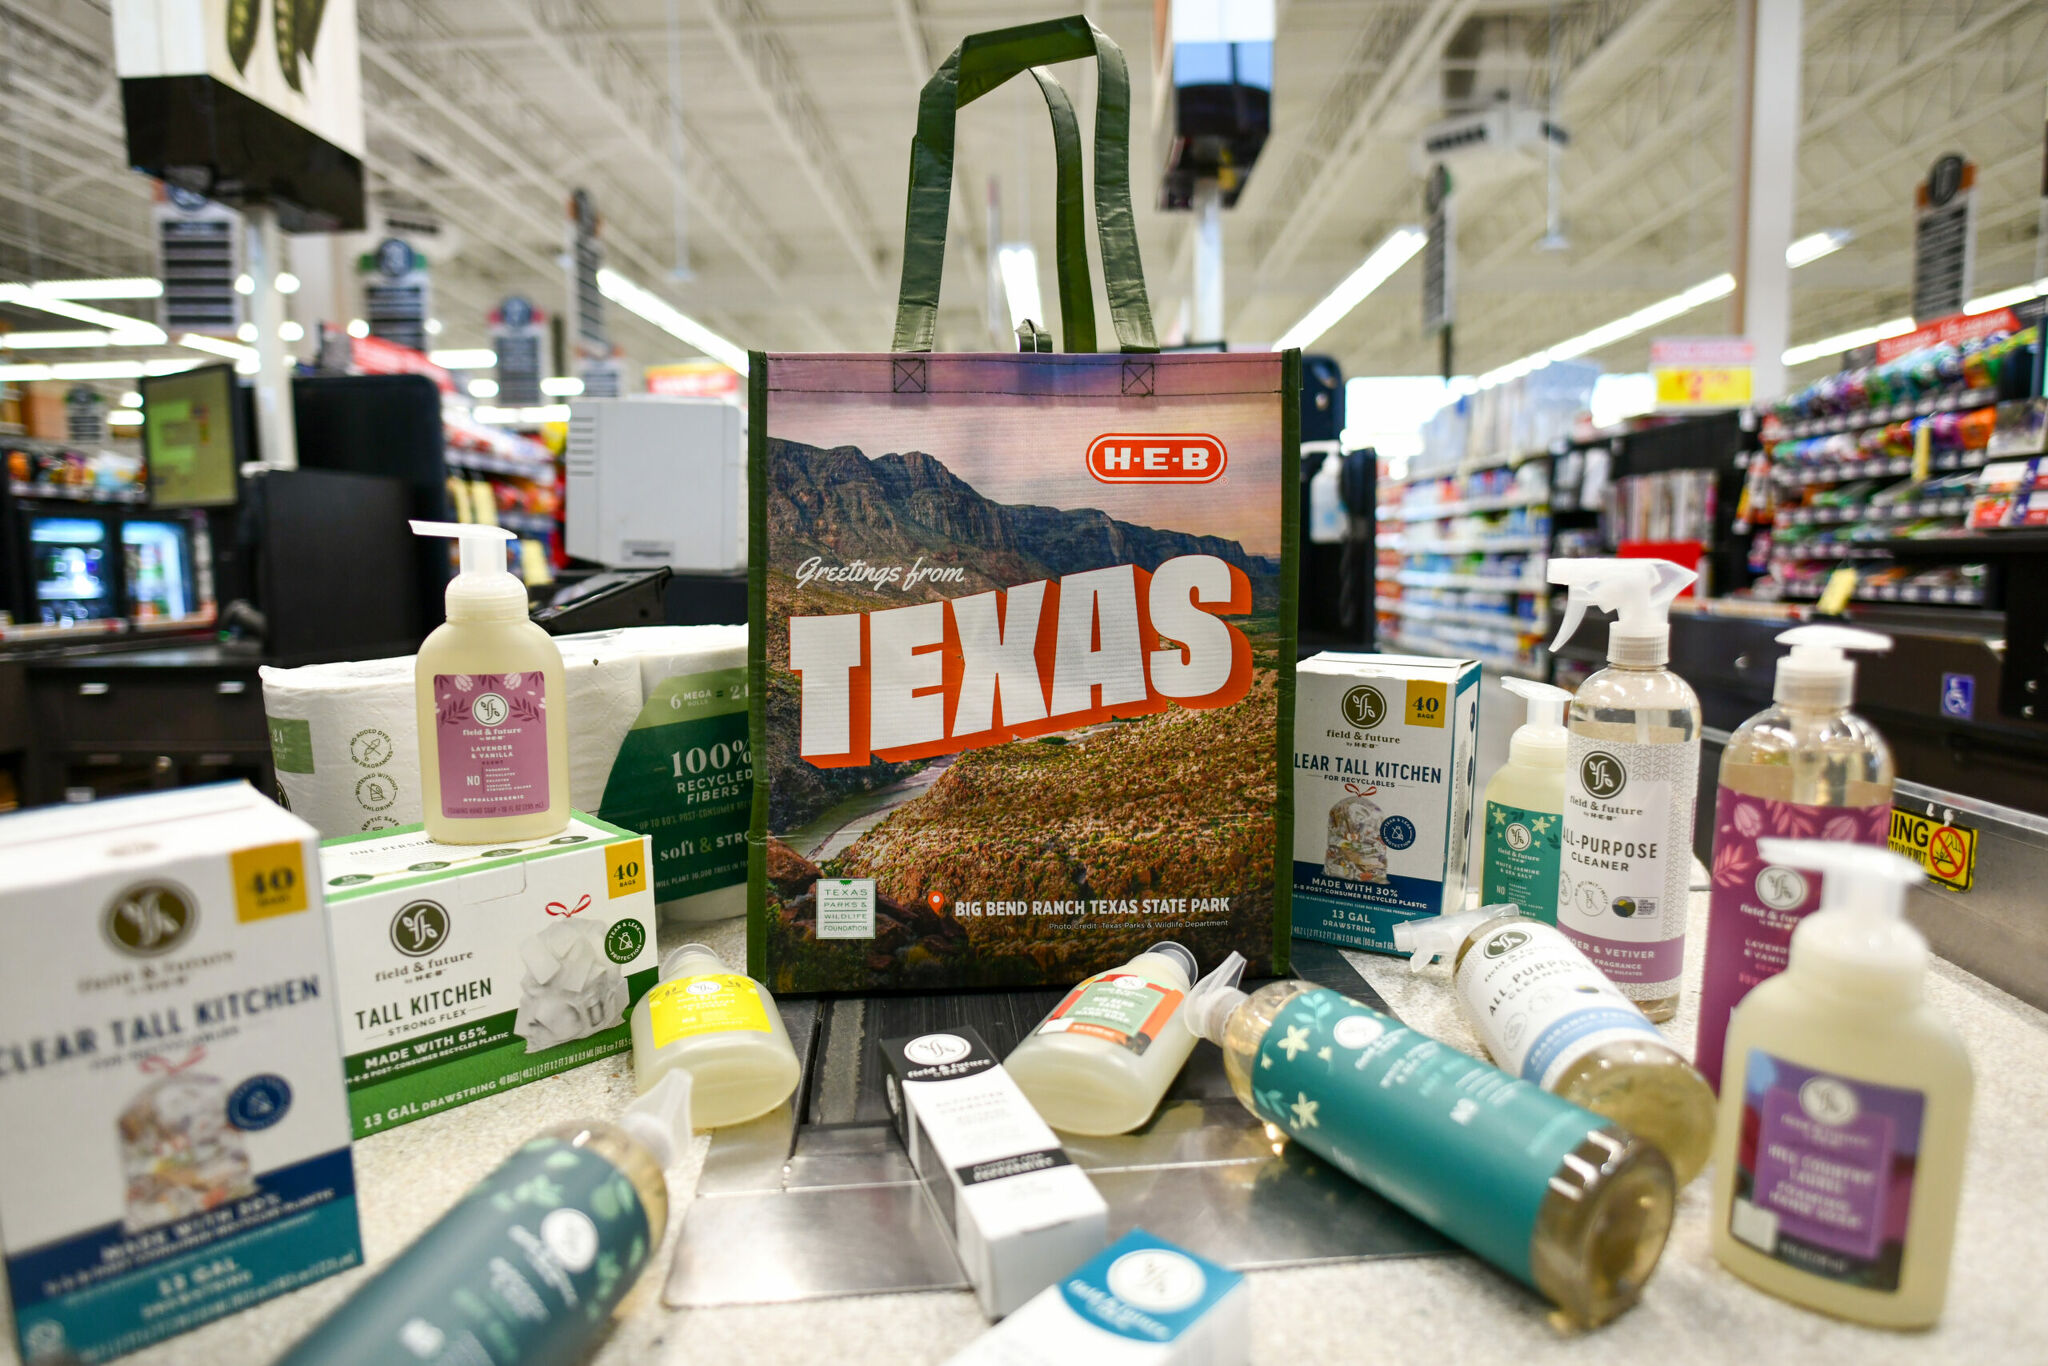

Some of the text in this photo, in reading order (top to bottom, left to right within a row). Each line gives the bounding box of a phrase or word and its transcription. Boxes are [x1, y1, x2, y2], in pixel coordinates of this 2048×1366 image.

[1104, 447, 1210, 470] H-E-B
[795, 556, 965, 592] Greetings from
[789, 554, 1253, 768] TEXAS
[670, 688, 712, 710] 6 MEGA
[1412, 696, 1439, 713] 40
[356, 728, 377, 738] ADDED
[1326, 730, 1400, 744] field & future
[671, 739, 752, 778] 100%
[1294, 752, 1442, 784] LEAR TALL KITCHEN
[377, 772, 398, 791] WITHOUT
[466, 776, 480, 786] NO
[676, 768, 753, 794] RECYCLED
[1341, 776, 1395, 788] RECYCLABLES
[362, 800, 394, 812] CHLORINE
[1590, 801, 1599, 811] &
[1601, 804, 1643, 816] future
[361, 815, 400, 831] SEPTIC SAFE
[660, 840, 695, 862] soft
[699, 836, 713, 854] &
[613, 861, 639, 881] 40
[1571, 851, 1629, 872] CLEANER
[619, 880, 636, 888] BAGS
[1312, 878, 1398, 898] MADE WITH 30%
[954, 896, 1230, 917] BIG BEND RANCH TEXAS STATE PARK
[1306, 885, 1362, 899] POST-CONSUMER
[1362, 892, 1397, 904] RECYCLED
[1399, 899, 1427, 909] PLASTIC
[1048, 922, 1072, 930] Photo
[1102, 922, 1122, 930] Texas
[1124, 921, 1145, 930] Parks
[1146, 920, 1153, 929] &
[1154, 920, 1183, 929] Wildlife
[1184, 920, 1229, 930] Department
[1322, 920, 1376, 934] DRAWSTRING
[1332, 909, 1371, 924] 13 GAL
[1593, 946, 1655, 959] & VETIVER
[374, 951, 474, 982] field & future
[1594, 959, 1642, 970] FRAGRANCE
[108, 1006, 183, 1047] TALL
[192, 974, 320, 1026] KITCHEN
[355, 976, 492, 1030] TALL KITCHEN
[388, 1008, 467, 1036] STRONG FLEX
[364, 1025, 488, 1069] MADE WITH 65%
[370, 1032, 510, 1077] POST-CONSUMER RECYCLED PLASTIC
[363, 1080, 497, 1129] 13 GAL DRAWSTRING
